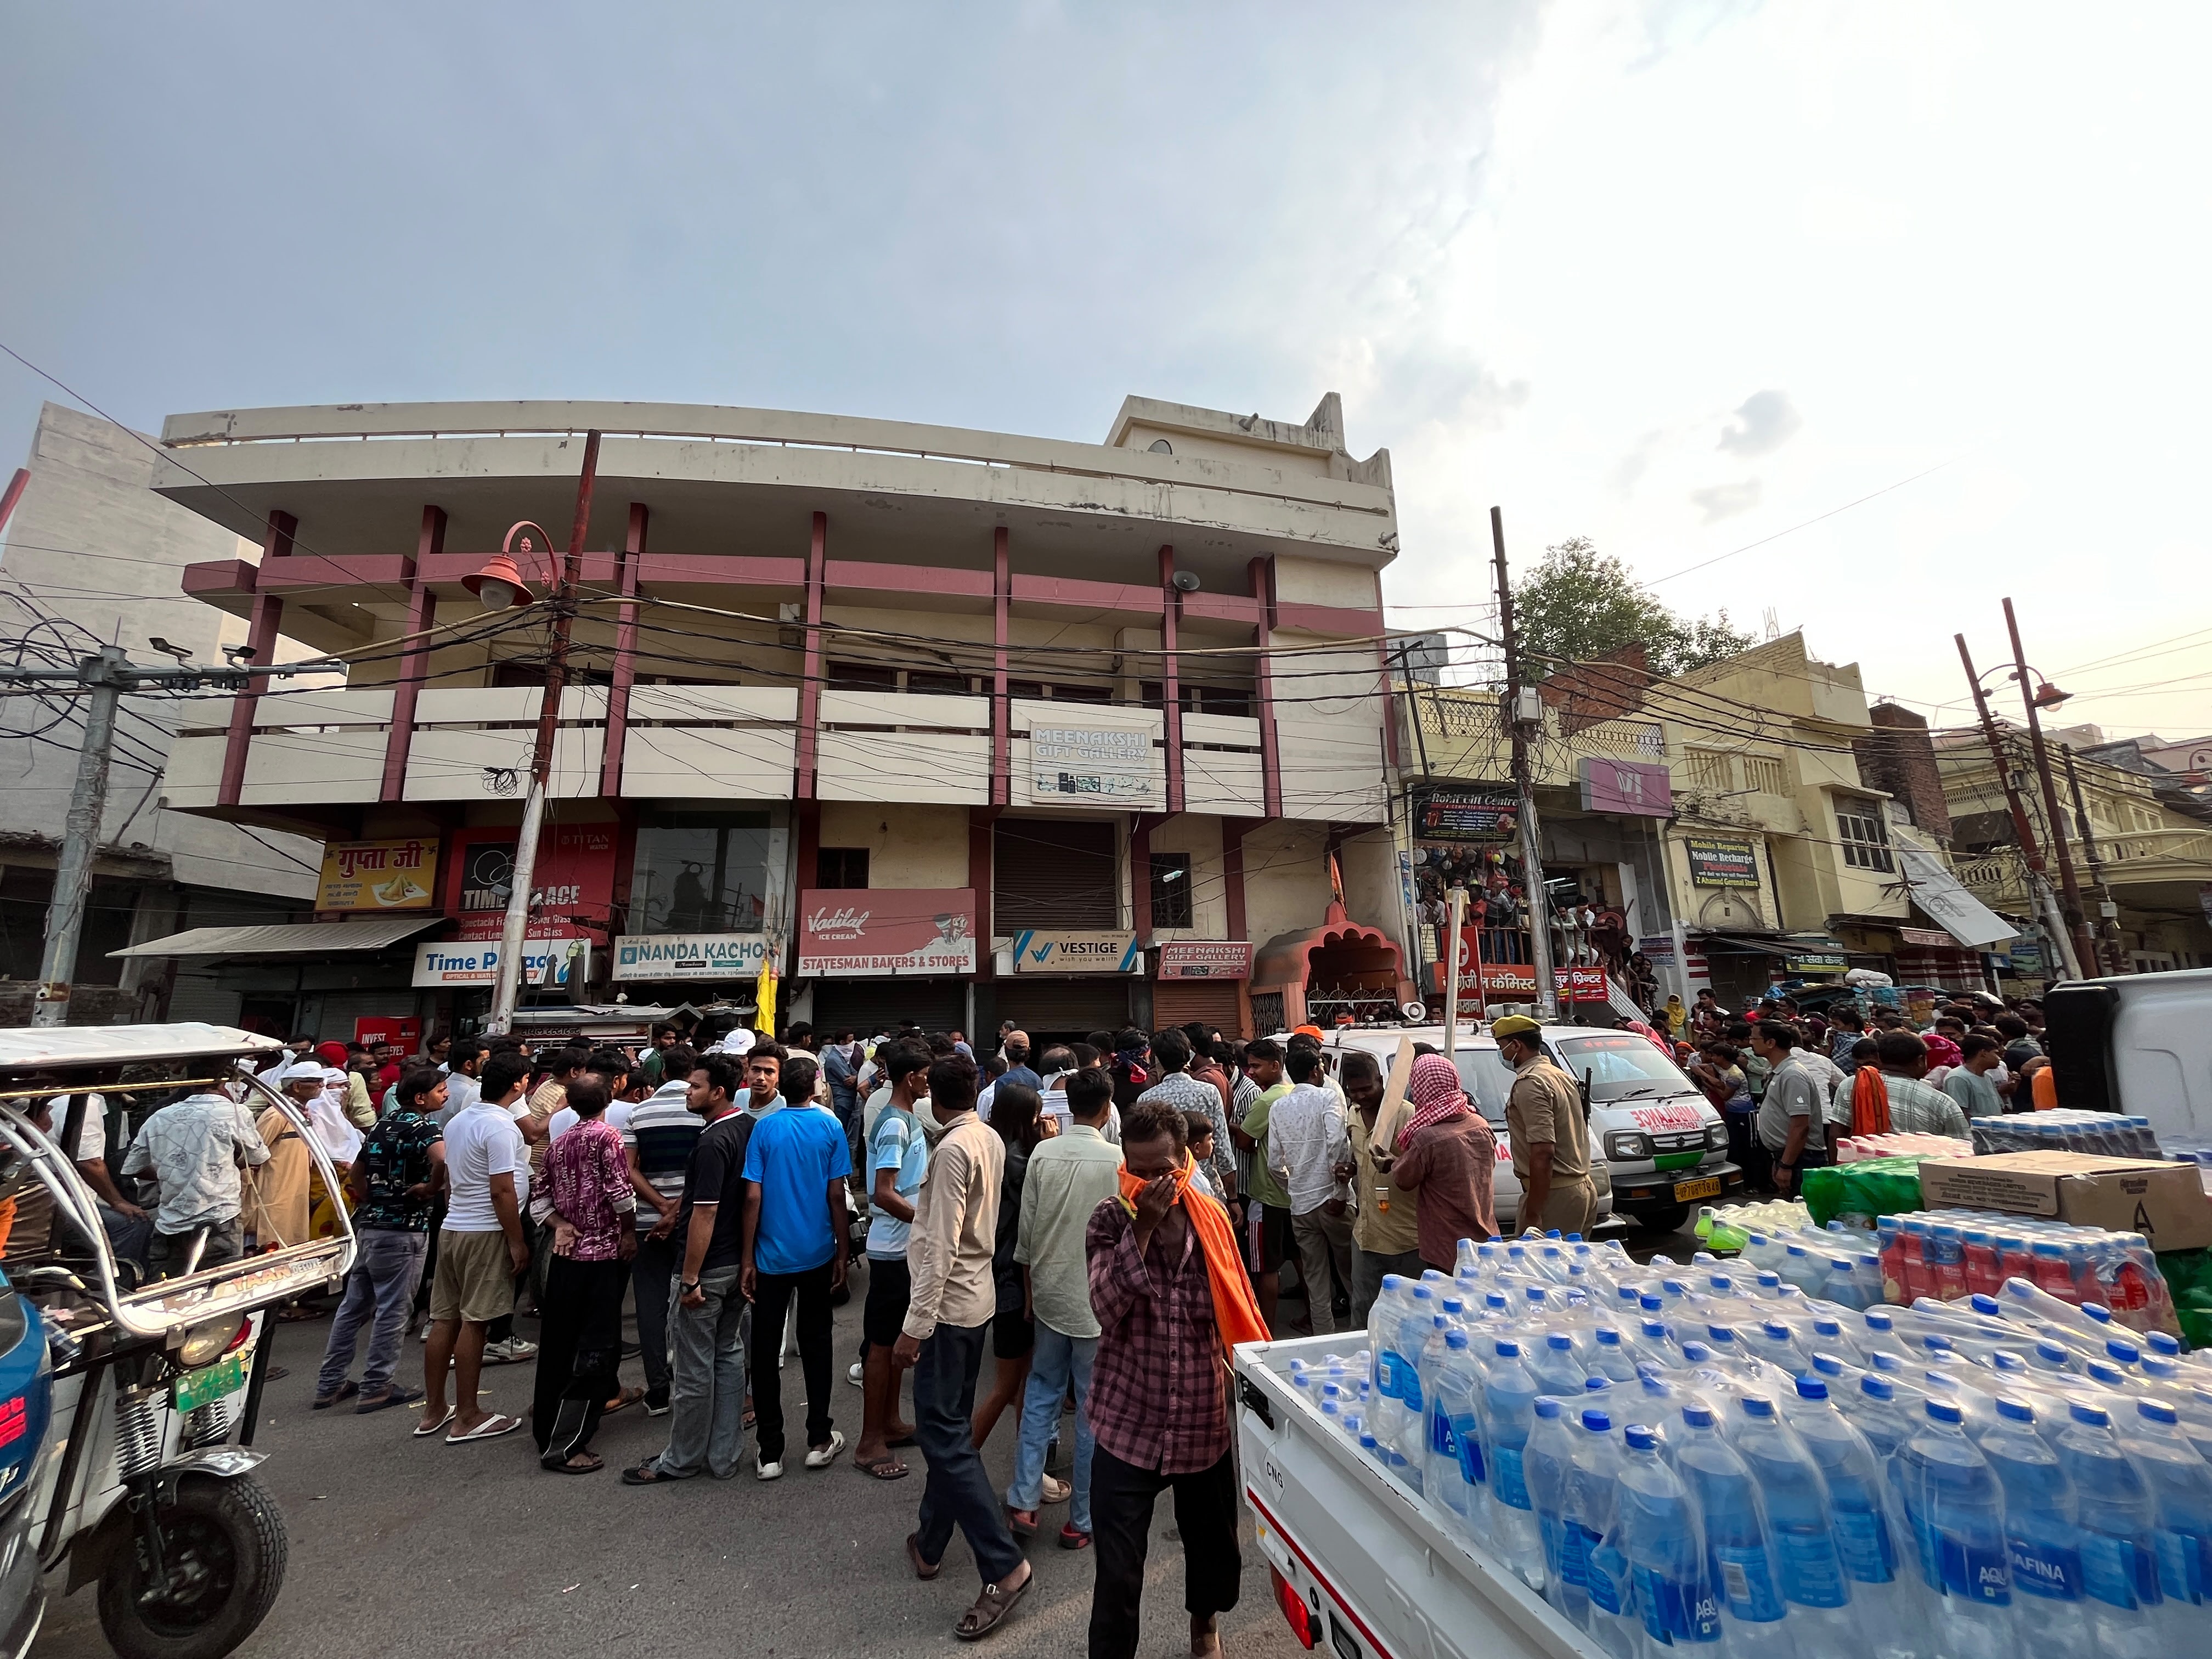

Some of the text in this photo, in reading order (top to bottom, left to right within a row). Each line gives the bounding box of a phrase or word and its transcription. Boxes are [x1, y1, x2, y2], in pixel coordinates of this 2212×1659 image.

[1035, 729, 1146, 747] MEENAKSHI
[1035, 744, 1148, 761] GIFT GALLERY
[1485, 795, 1518, 806] Centre
[572, 834, 608, 844] TITAN
[1691, 840, 1716, 849] Mobile
[338, 840, 425, 879] गुप्ता जी
[1691, 850, 1753, 864] Mobile Recharge
[464, 890, 505, 909] TIME
[460, 918, 494, 928] Spectacle
[808, 907, 870, 935] Vadilal
[459, 932, 486, 940] Contact
[528, 928, 563, 938] Sun Glass
[639, 944, 699, 961] NANDA
[1059, 943, 1118, 953] VESTIGE
[426, 953, 476, 970] Time
[803, 955, 969, 970] STATESMAN BAKERS & STORES
[1572, 972, 1602, 985] प्रिन्टर
[362, 1033, 386, 1044] INVEST
[1267, 1462, 1283, 1488] CNG
